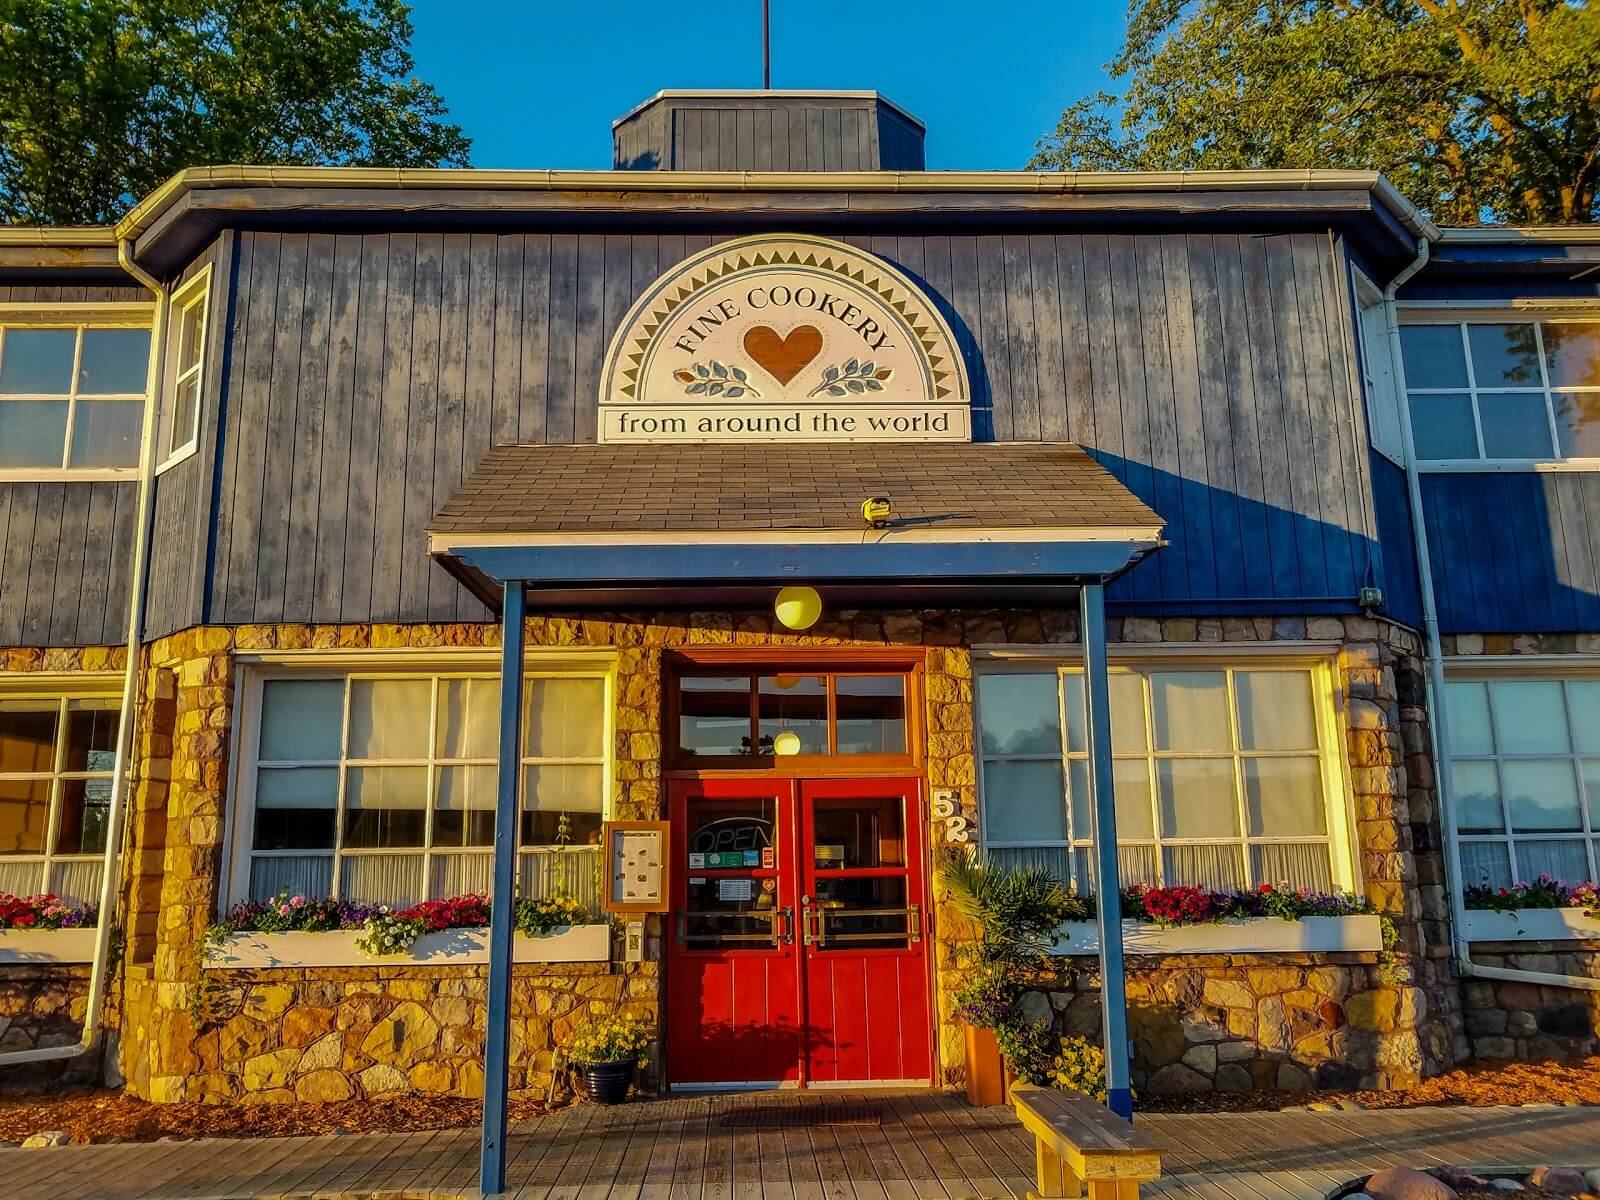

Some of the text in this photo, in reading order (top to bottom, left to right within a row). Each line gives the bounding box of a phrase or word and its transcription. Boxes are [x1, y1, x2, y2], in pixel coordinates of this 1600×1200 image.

[675, 285, 895, 355] FINE COOKERY
[619, 412, 949, 433] from around the world
[693, 825, 776, 853] OPEN
